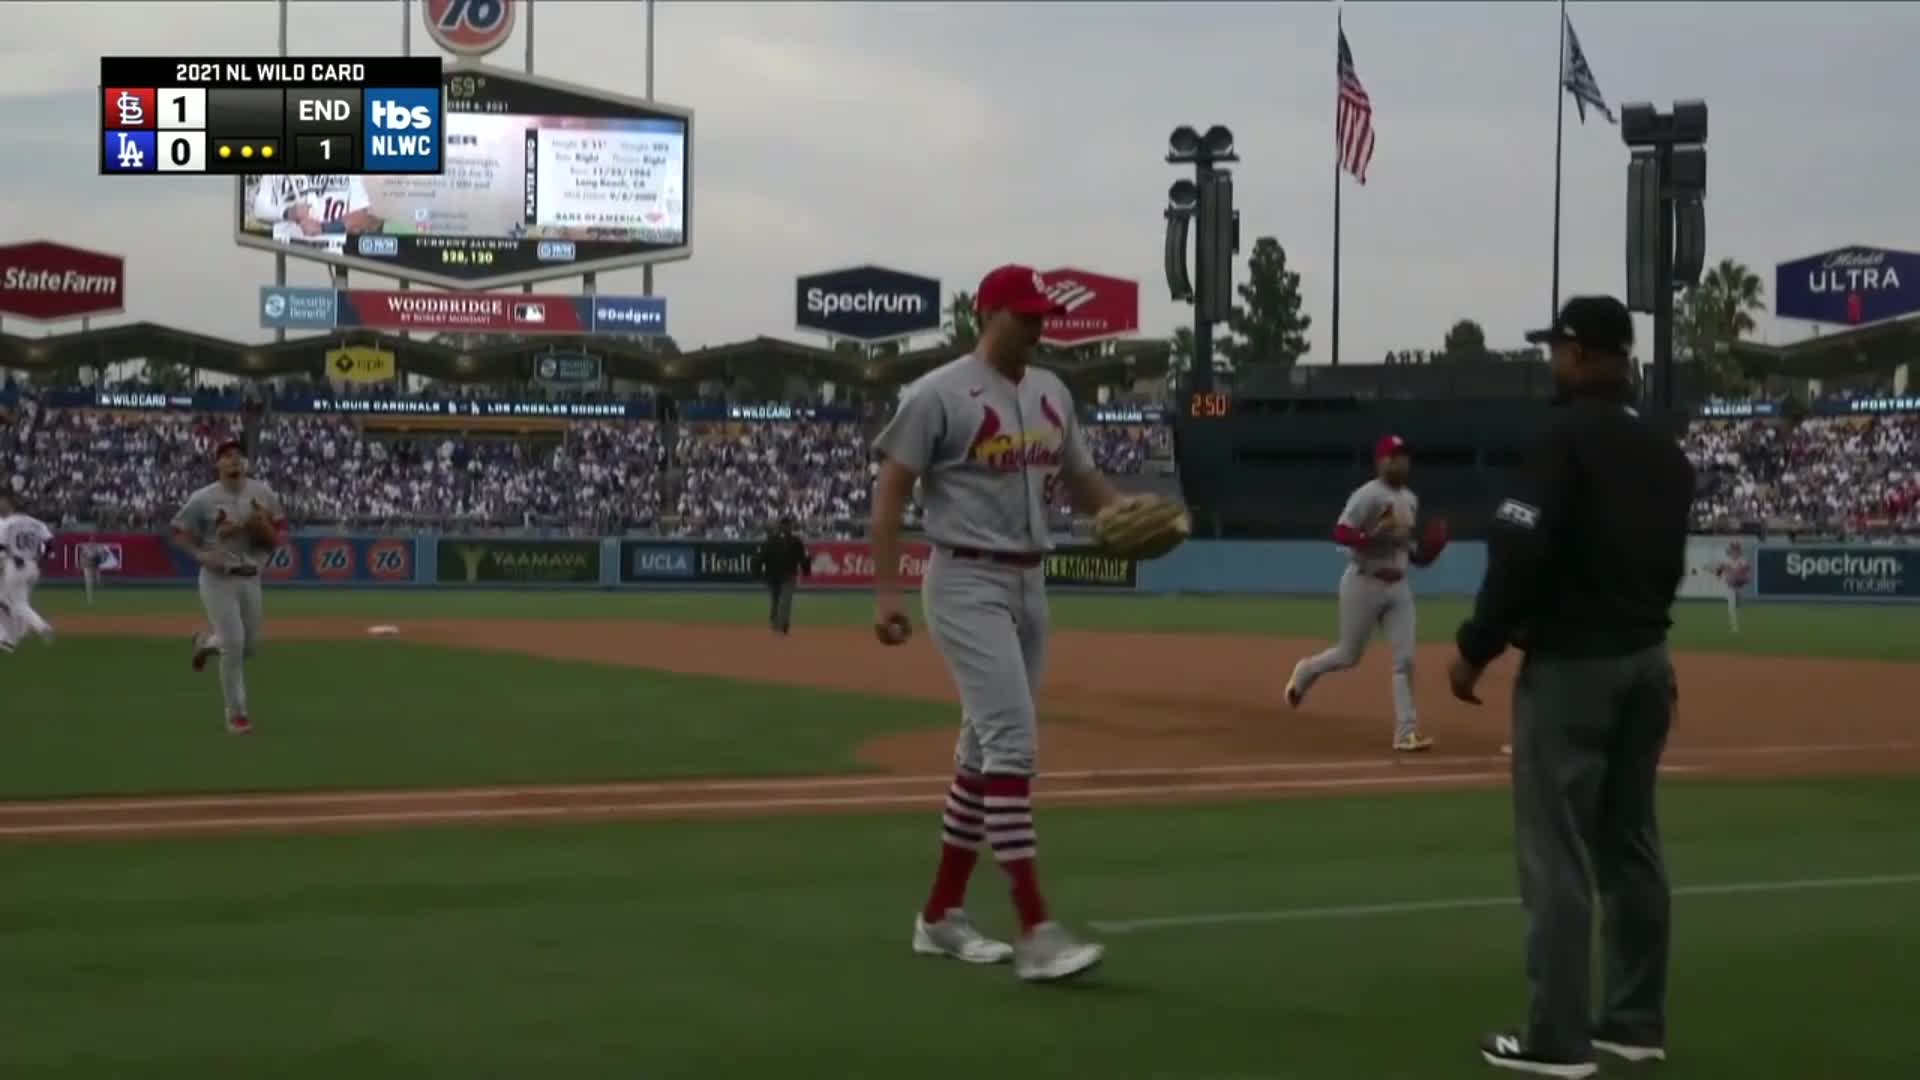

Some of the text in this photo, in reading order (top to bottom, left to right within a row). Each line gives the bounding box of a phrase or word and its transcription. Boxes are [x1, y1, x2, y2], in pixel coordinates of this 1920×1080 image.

[1809, 266, 1901, 292] ULTRA
[387, 296, 503, 315] WOODBRIDGE
[806, 287, 922, 315] Spectrum
[598, 308, 661, 324] @Dodgers
[320, 544, 348, 568] 76
[376, 544, 404, 568] 76
[641, 552, 753, 574] UCLA Healt
[1786, 553, 1897, 580] Spectrum
[1843, 577, 1897, 593] mobile
[1496, 1035, 1520, 1054] N
